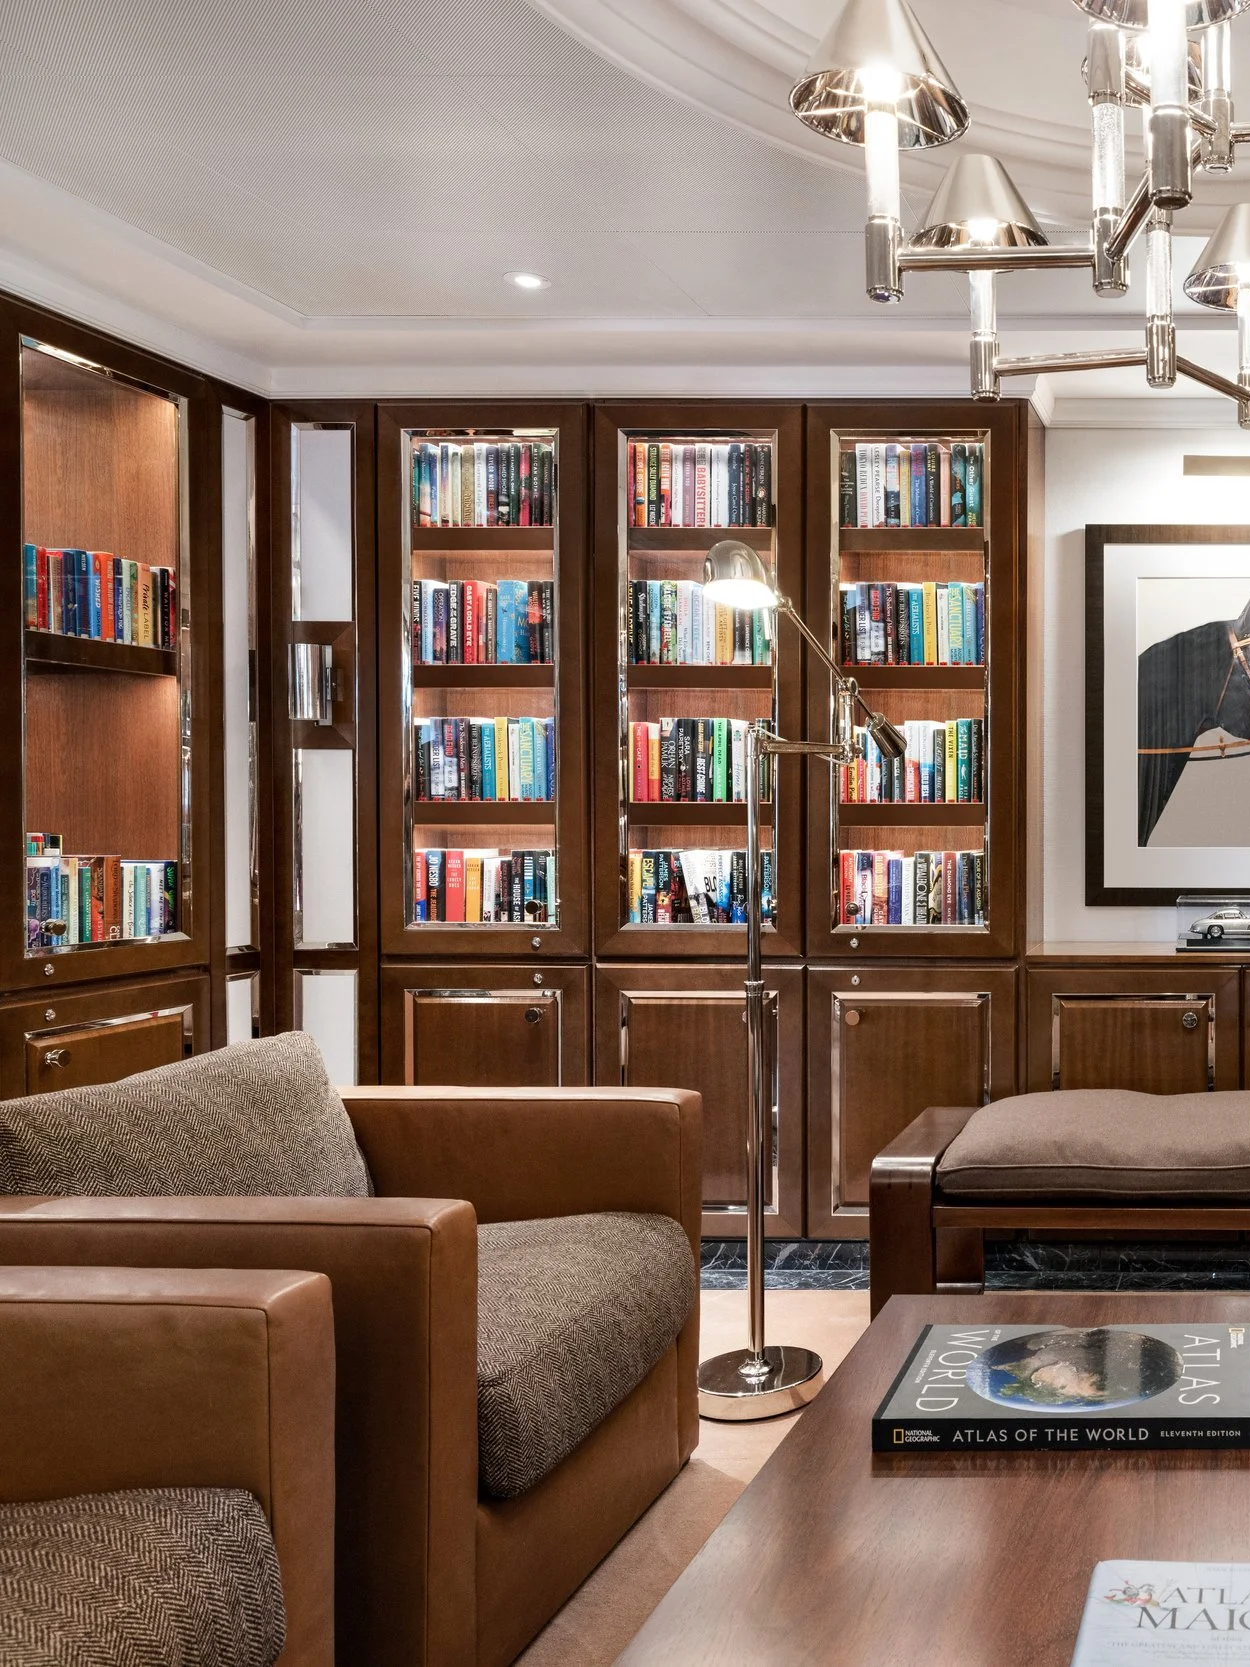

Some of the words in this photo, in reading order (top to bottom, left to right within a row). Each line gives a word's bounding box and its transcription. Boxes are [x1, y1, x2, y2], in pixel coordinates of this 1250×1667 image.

[697, 467, 706, 523] BABYSITTER
[874, 495, 882, 522] Deception
[142, 584, 150, 612] Private
[871, 590, 880, 606] DEAD
[949, 595, 962, 648] SANCTUARY
[445, 725, 453, 741] DEAD
[445, 742, 453, 756] FIND
[520, 731, 532, 785] SANCTUARY
[668, 740, 676, 768] ORHAN
[960, 734, 968, 760] MAID
[697, 757, 706, 774] BEST
[697, 774, 705, 794] CRIME
[429, 854, 437, 864] JO
[643, 858, 654, 887] ESCAPE
[513, 884, 521, 905] HOUSE
[923, 1350, 937, 1368] ELEVENTH
[1178, 1334, 1221, 1405] ATLAS
[914, 1367, 928, 1384] EDITION
[916, 1330, 990, 1412] WORLD
[953, 1430, 1008, 1442] ATLAS
[1015, 1429, 1038, 1442] OF
[1044, 1429, 1079, 1441] THE
[1085, 1428, 1149, 1441] WORLD
